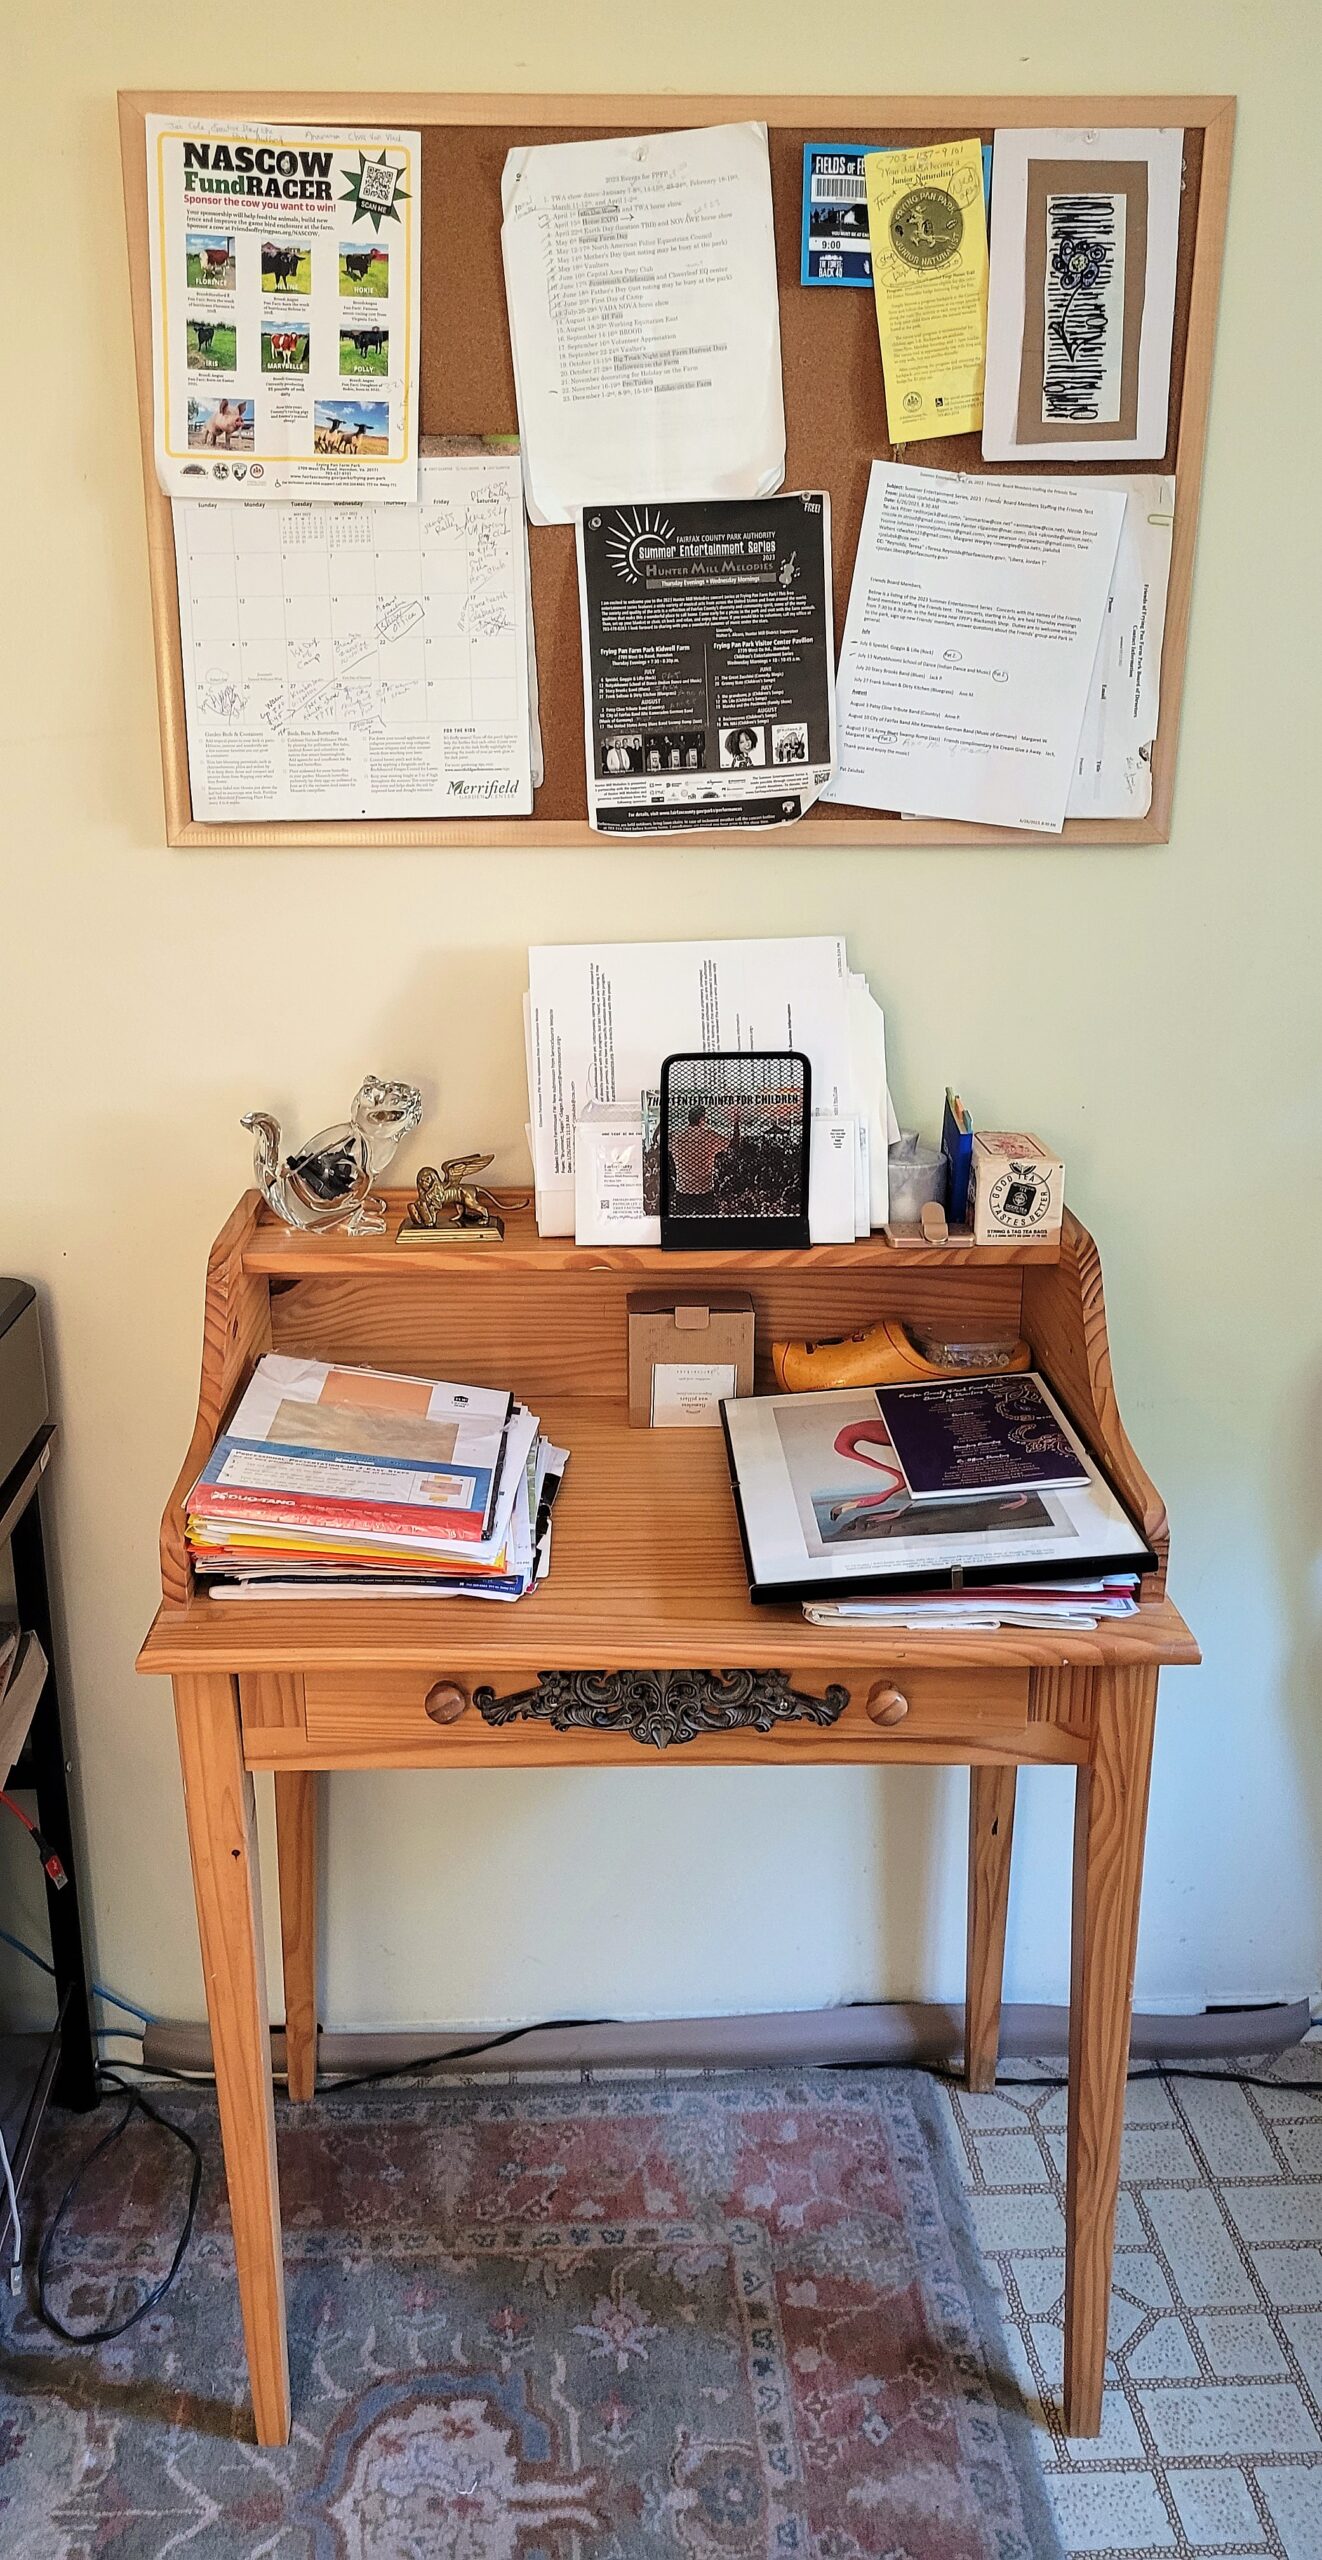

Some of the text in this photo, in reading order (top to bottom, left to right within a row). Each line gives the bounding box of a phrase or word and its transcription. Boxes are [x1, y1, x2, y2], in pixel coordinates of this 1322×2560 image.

[183, 142, 333, 177] NASCOW
[816, 157, 845, 173] FIELDS
[847, 164, 856, 173] OF
[891, 169, 954, 185] Junior Naturalist!
[184, 171, 332, 201] FundRACER
[184, 195, 336, 212] Sponsor the cow you want to win!
[361, 201, 387, 213] SCAN ME
[895, 193, 956, 220] FRYING PAN PARK
[201, 210, 232, 218] sponsorship
[214, 218, 235, 226] improve
[822, 240, 841, 249] 9:00
[895, 234, 959, 265] JUNIOR NATURALIST
[819, 269, 835, 278] BACK
[195, 279, 227, 287] FLORENCE
[268, 362, 303, 370] MARYBELLE
[354, 365, 374, 373] POLLY
[804, 502, 820, 513] FREE!
[923, 489, 954, 498] Entertainment
[1040, 503, 1057, 511] Staffing
[677, 535, 700, 543] FAIRFAX
[702, 534, 725, 542] COUNTY
[743, 532, 775, 540] AUTHORITY
[639, 541, 775, 559] Summer Entertainment Series
[646, 560, 773, 577] HUNTER MILL MELODIES
[661, 576, 760, 588] Thursday Evenings Wednesday Mornings
[600, 648, 617, 656] Frying
[446, 780, 519, 799] Merrifield
[992, 1174, 1035, 1198] GOOD TEA
[993, 1192, 1047, 1225] TASTES BETTER
